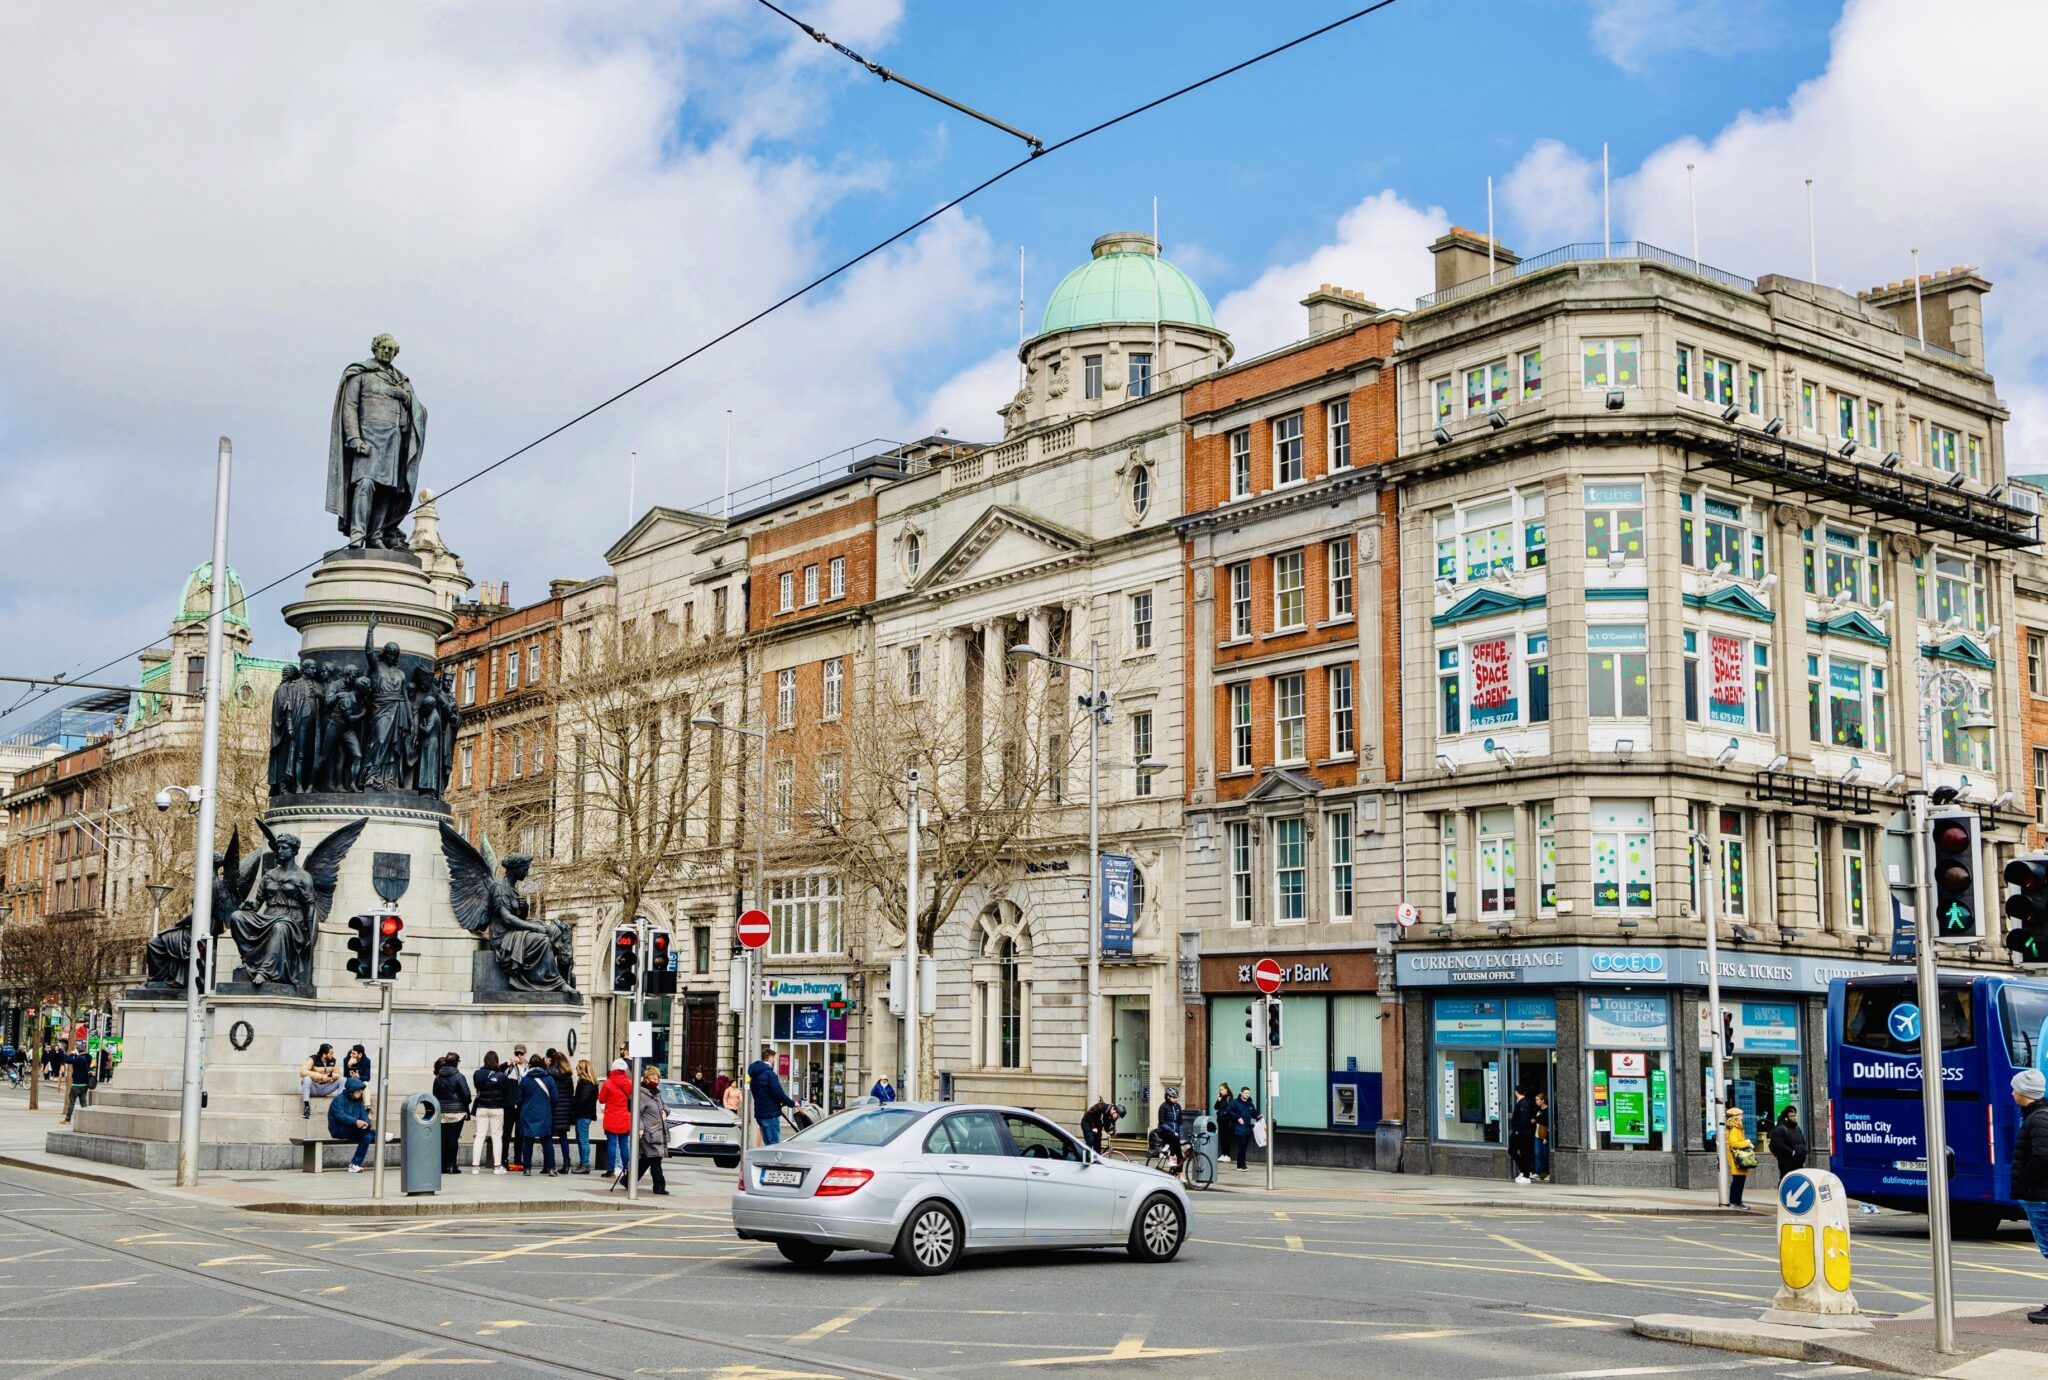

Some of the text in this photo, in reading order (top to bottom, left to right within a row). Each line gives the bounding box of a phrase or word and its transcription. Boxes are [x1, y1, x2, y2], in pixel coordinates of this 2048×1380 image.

[1588, 488, 1633, 500] tcube
[1601, 632, 1638, 640] O'Connell
[1473, 640, 1506, 664] OFFICE
[1712, 636, 1739, 661] OFFICE
[1714, 656, 1740, 683] SPACE
[1475, 663, 1509, 691] SPACE
[1473, 686, 1508, 710] TO RENT
[1714, 686, 1743, 706] TO RENT
[1471, 713, 1515, 726] 01 675 9777
[1720, 712, 1731, 722] 675
[1411, 952, 1564, 971] CURRENCY EXCHANGE
[1295, 963, 1330, 982] Bank
[1452, 971, 1516, 981] TOURISM OFFICE
[1737, 964, 1747, 978] &
[1748, 964, 1793, 980] TICKETS
[1602, 998, 1640, 1010] Tours
[1612, 1010, 1664, 1022] Tickets
[1853, 1062, 1964, 1081] DublinExess
[1844, 1113, 1871, 1121] Between
[1845, 1121, 1892, 1132] Dublin City
[1845, 1133, 1917, 1146] & Dublin Airport
